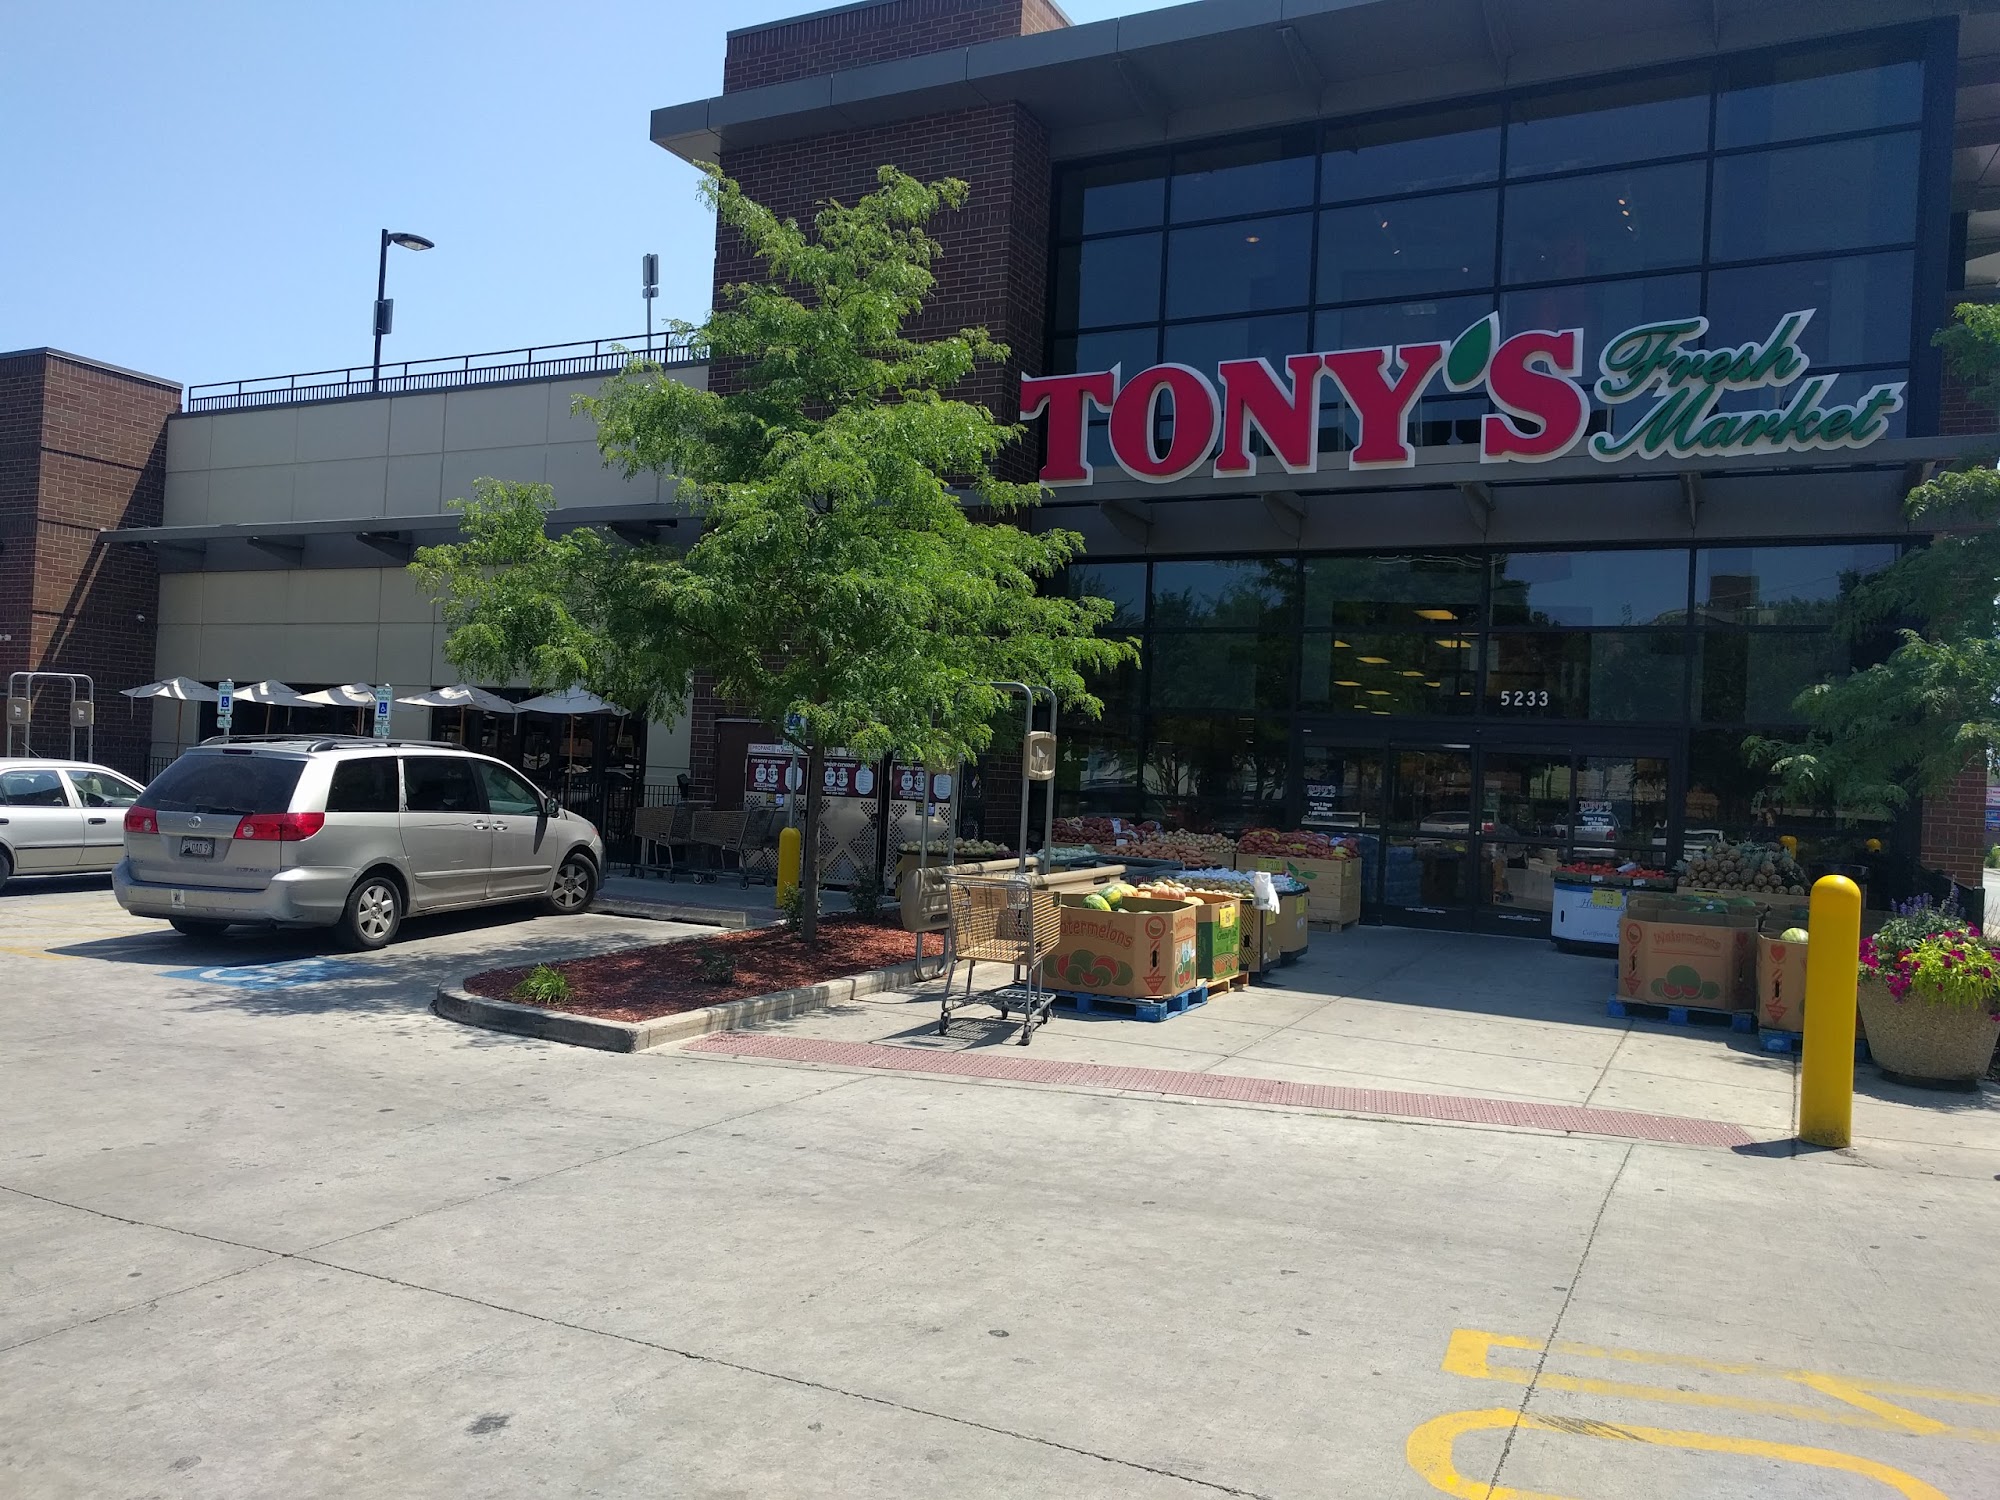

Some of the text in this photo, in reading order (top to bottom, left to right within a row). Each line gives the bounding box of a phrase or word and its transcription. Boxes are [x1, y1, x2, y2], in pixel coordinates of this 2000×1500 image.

[1598, 312, 1808, 400] Fresh
[1019, 312, 1589, 485] TONY'S
[1592, 376, 1903, 457] Market
[1500, 690, 1548, 706] 5233
[1059, 914, 1133, 949] atermelons
